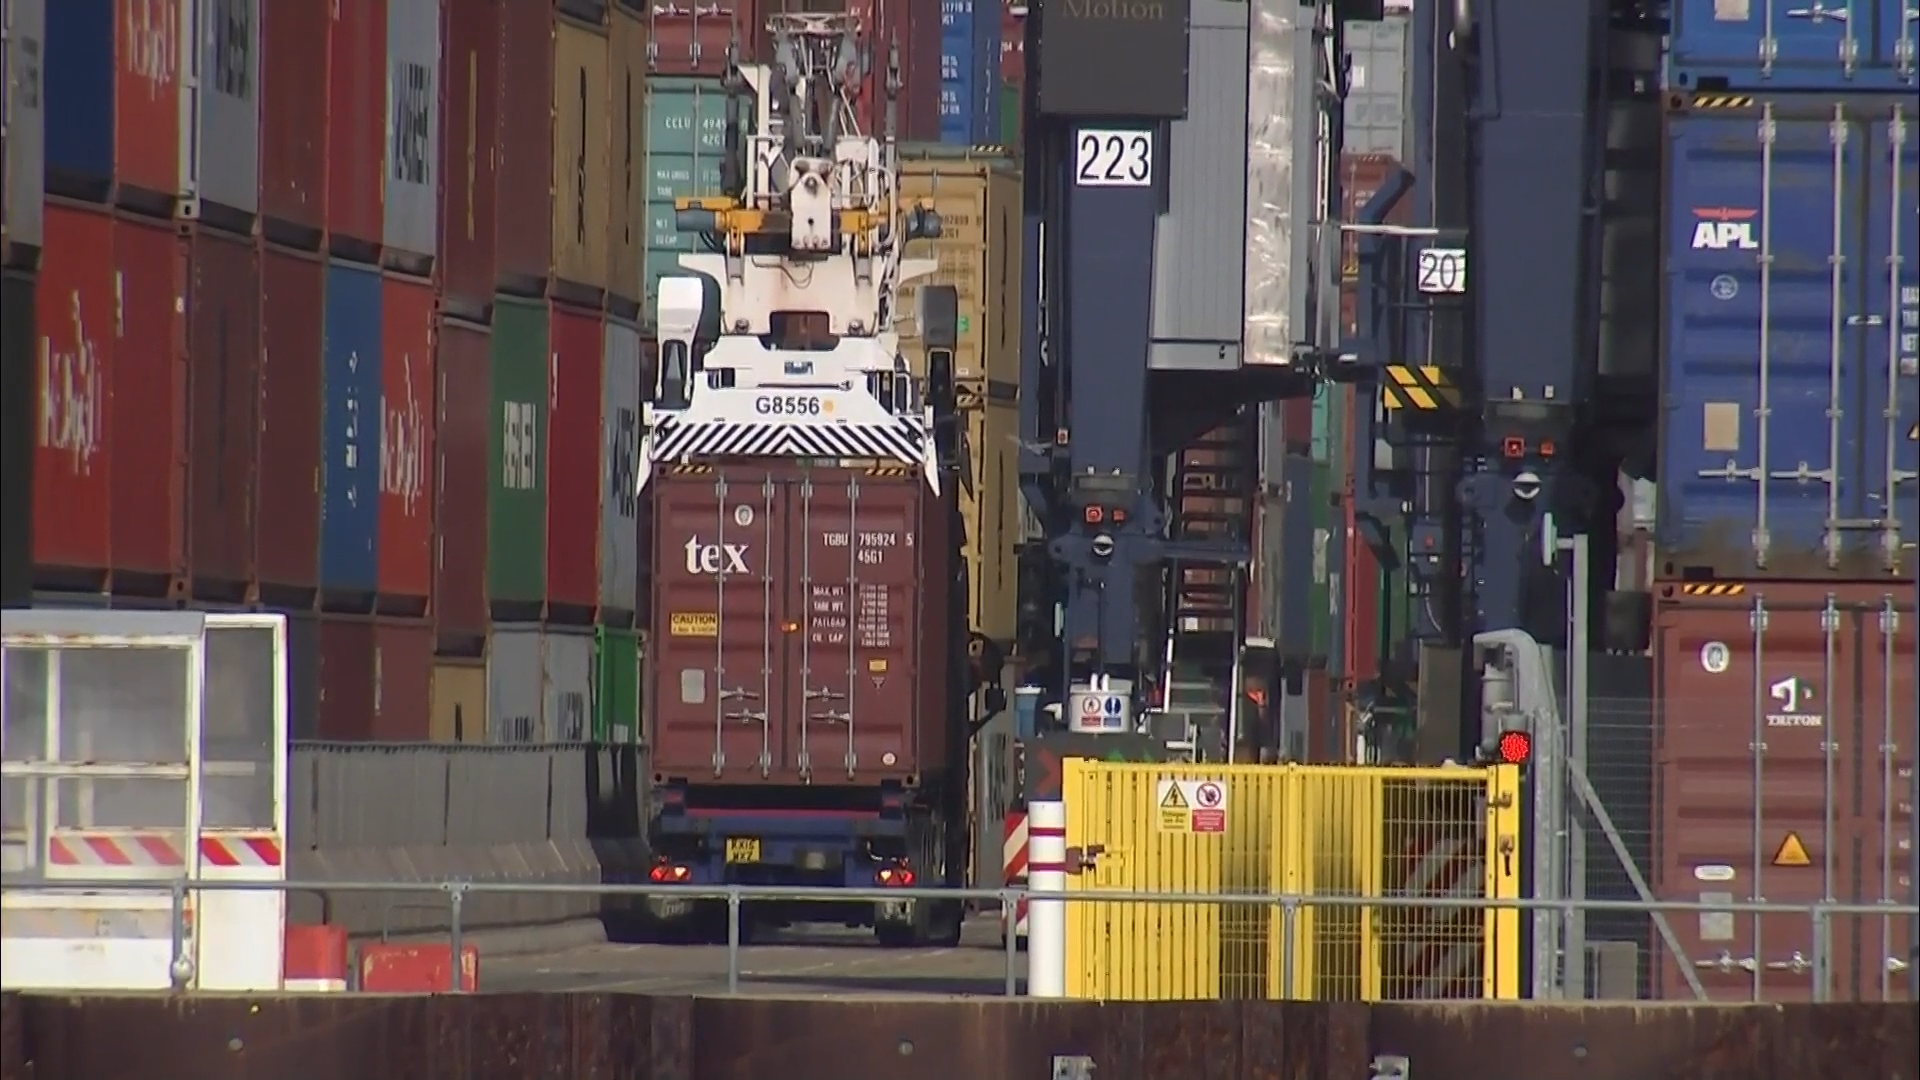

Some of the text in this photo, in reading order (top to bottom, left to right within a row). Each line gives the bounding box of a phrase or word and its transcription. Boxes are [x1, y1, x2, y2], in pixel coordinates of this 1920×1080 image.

[1063, 0, 1165, 19] Motion
[665, 118, 691, 128] CCLU
[1080, 135, 1149, 181] 223
[1692, 222, 1759, 248] APL
[1420, 253, 1465, 289] 20
[756, 396, 820, 416] G8556
[823, 533, 913, 547] TGBU 795924 5
[684, 534, 749, 574] tex
[858, 550, 883, 564] 45G1
[672, 615, 716, 624] CAUTION
[1766, 714, 1822, 726] TRITON
